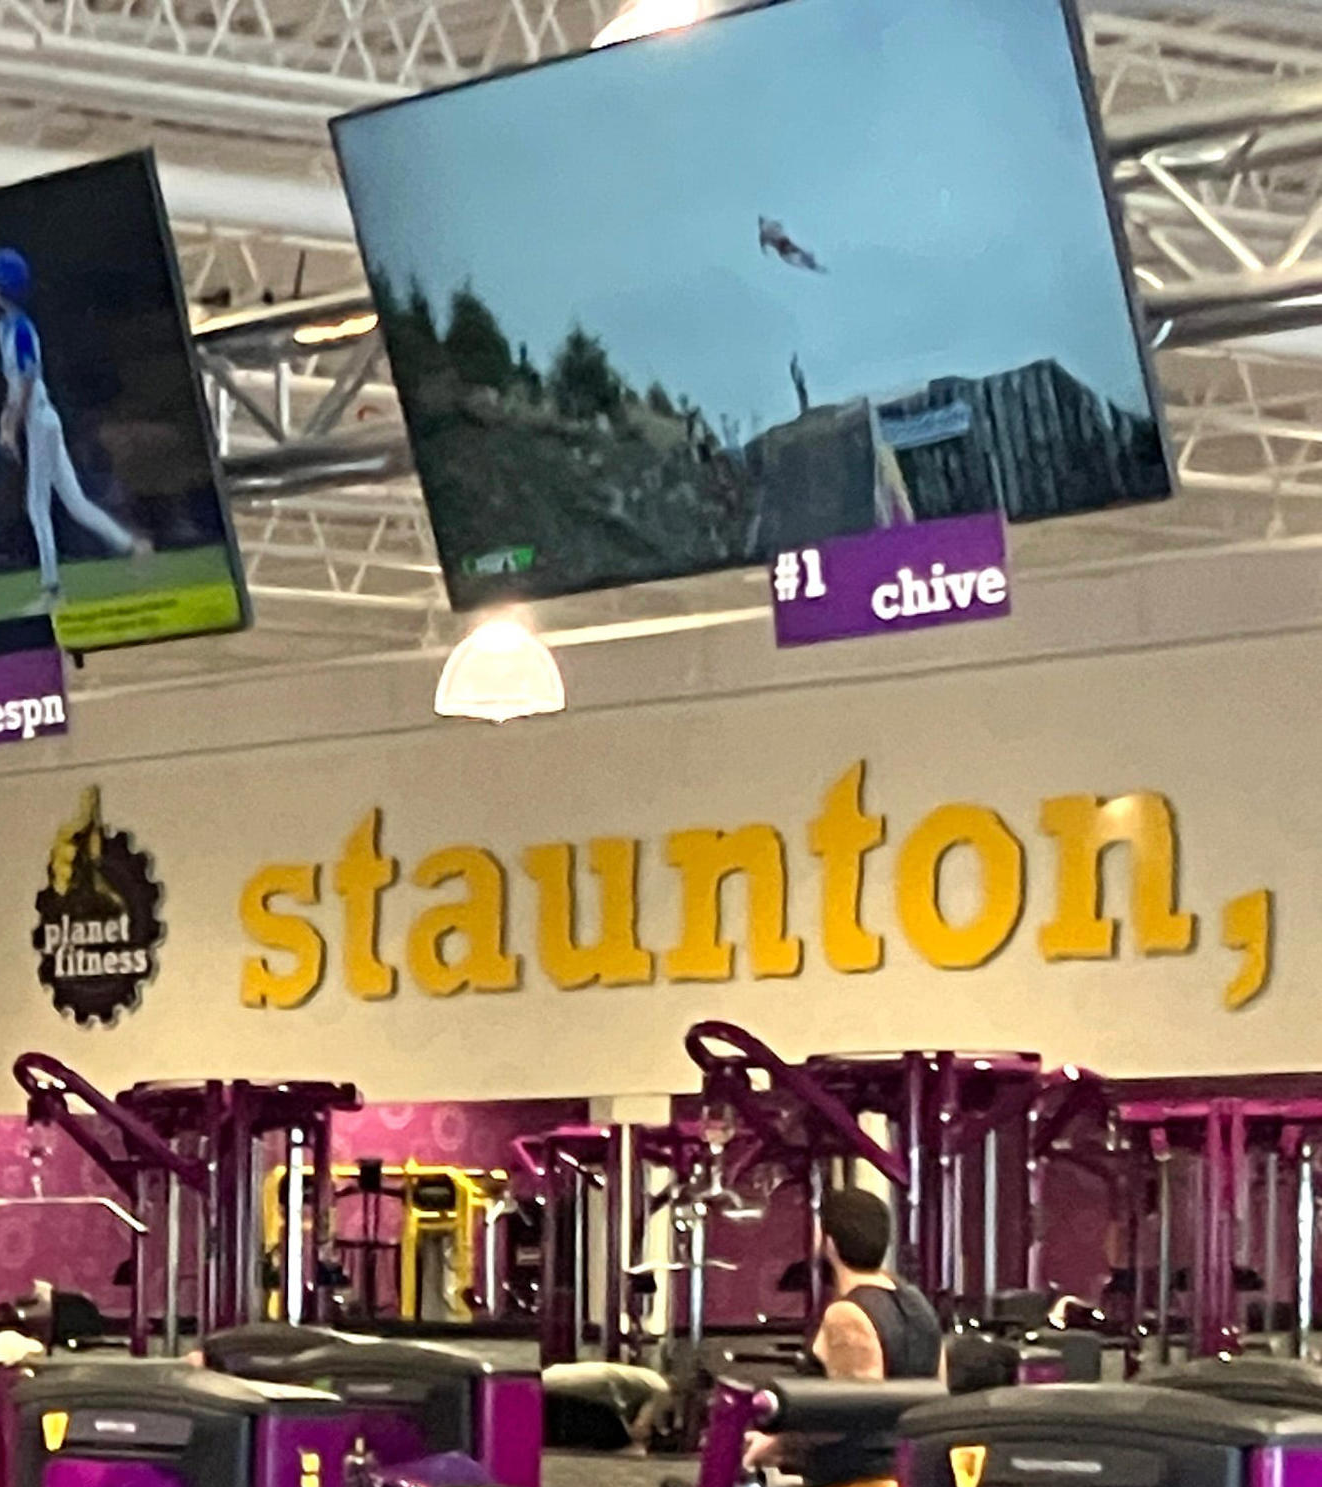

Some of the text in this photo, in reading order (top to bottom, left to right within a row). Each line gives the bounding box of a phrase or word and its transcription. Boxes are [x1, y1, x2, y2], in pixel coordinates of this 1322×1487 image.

[775, 549, 1006, 620] #1 chive
[239, 759, 1273, 1011] staunton,
[44, 913, 129, 954] planet
[55, 943, 148, 978] fitness
